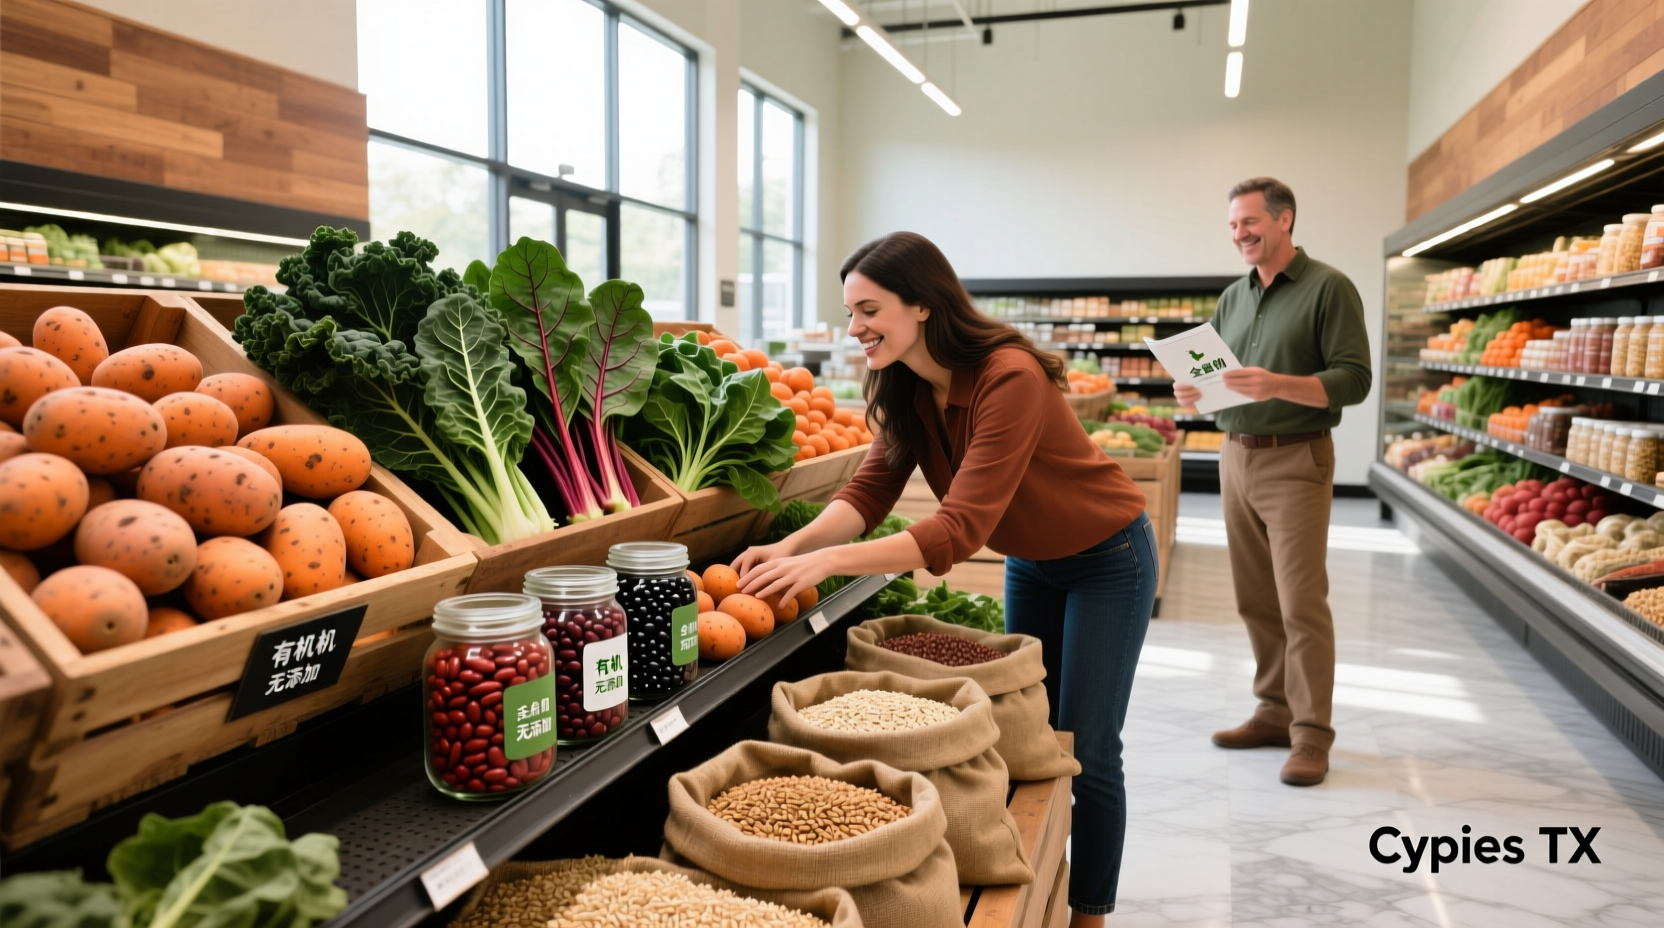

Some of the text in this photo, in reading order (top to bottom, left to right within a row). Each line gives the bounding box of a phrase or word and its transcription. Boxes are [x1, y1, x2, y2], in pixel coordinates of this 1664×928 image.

[272, 629, 336, 669] 有机机
[264, 663, 321, 696] 无添加
